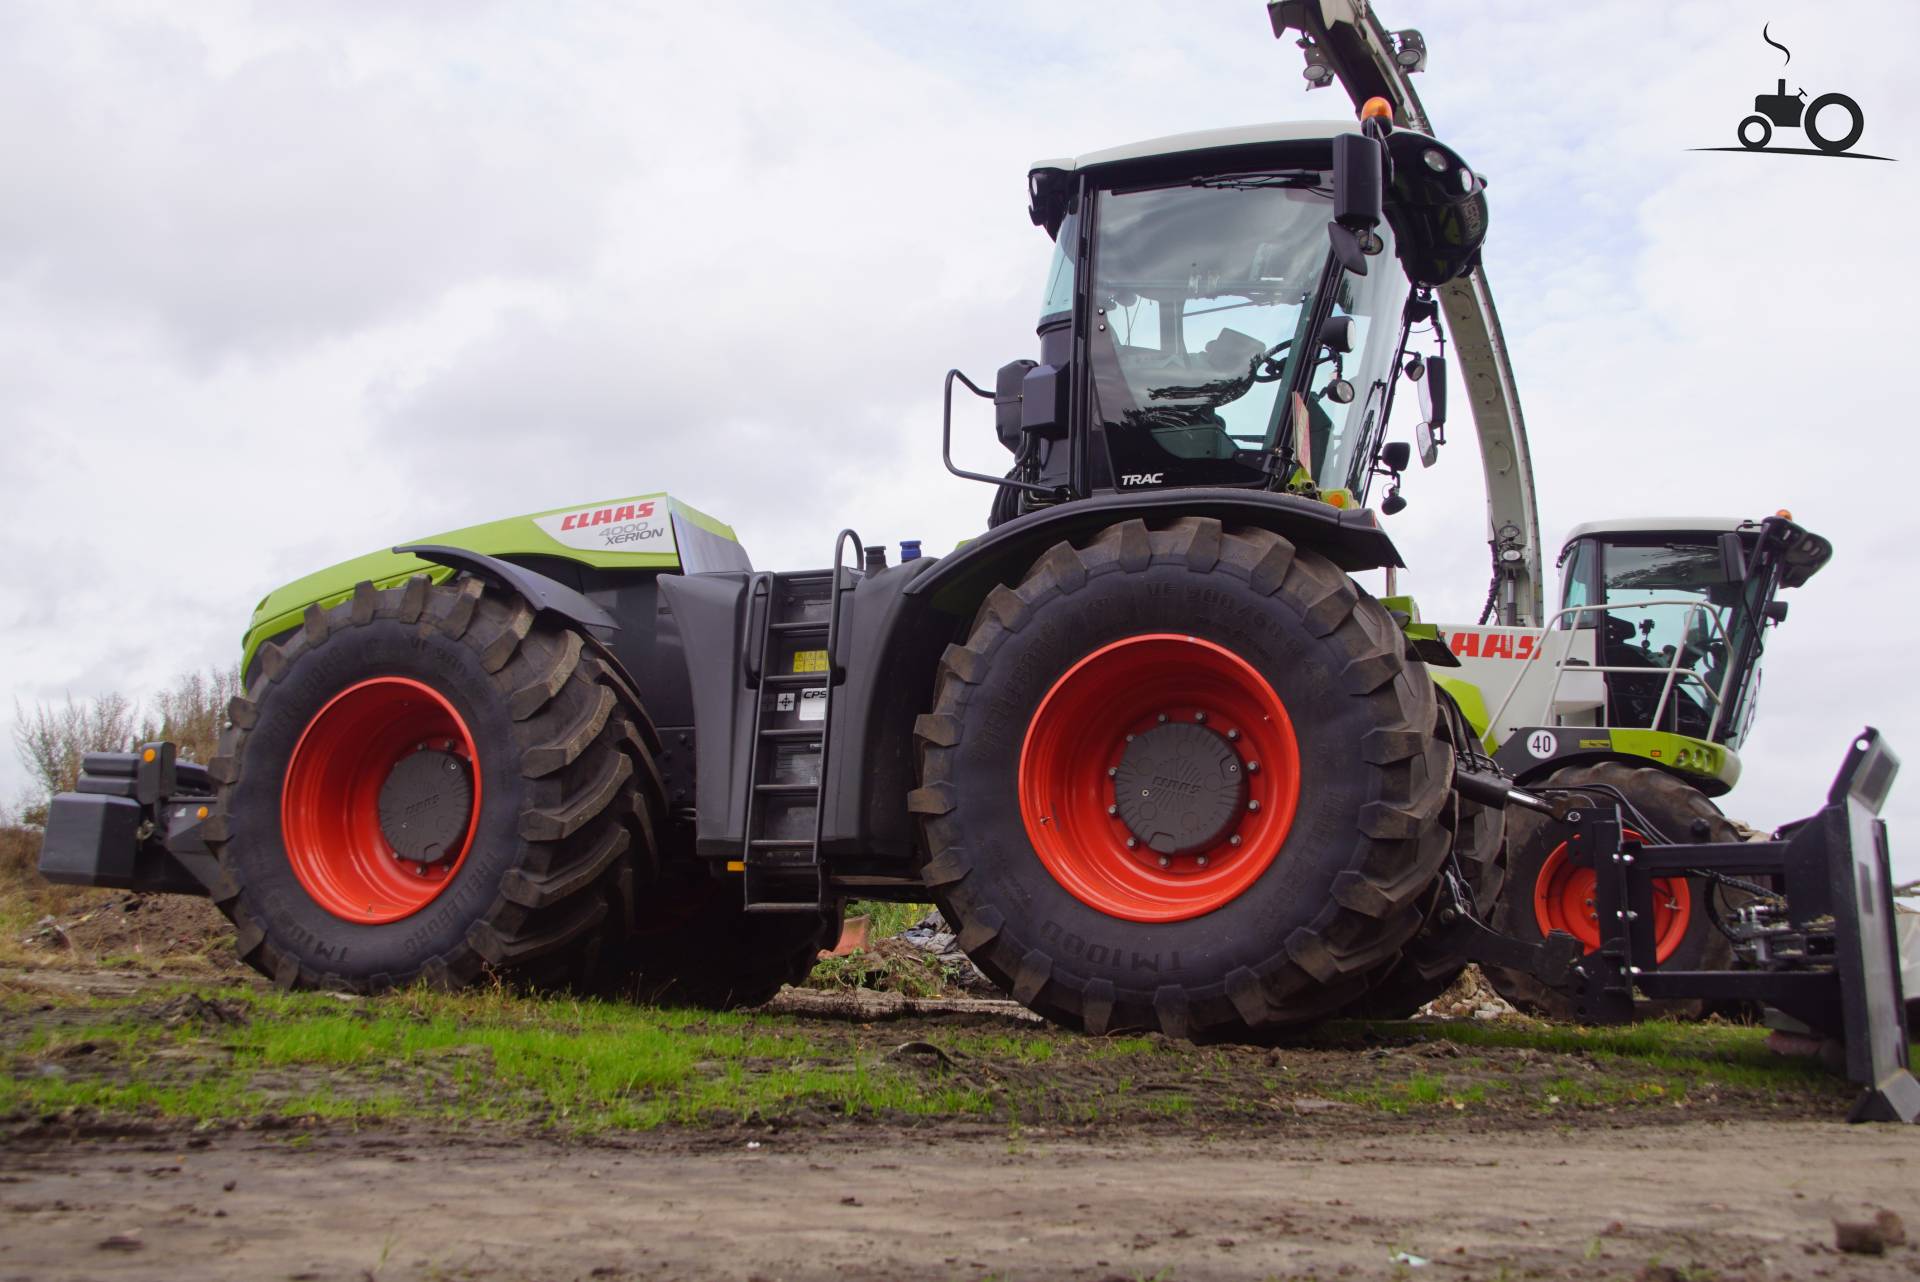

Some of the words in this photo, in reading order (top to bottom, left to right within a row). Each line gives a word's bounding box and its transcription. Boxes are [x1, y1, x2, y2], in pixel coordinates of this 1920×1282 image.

[1121, 473, 1164, 486] TRAC
[560, 501, 656, 531] CLAAS
[599, 521, 648, 537] 4000
[604, 528, 664, 546] XERION
[803, 690, 827, 699] CPS
[1532, 735, 1551, 753] 40
